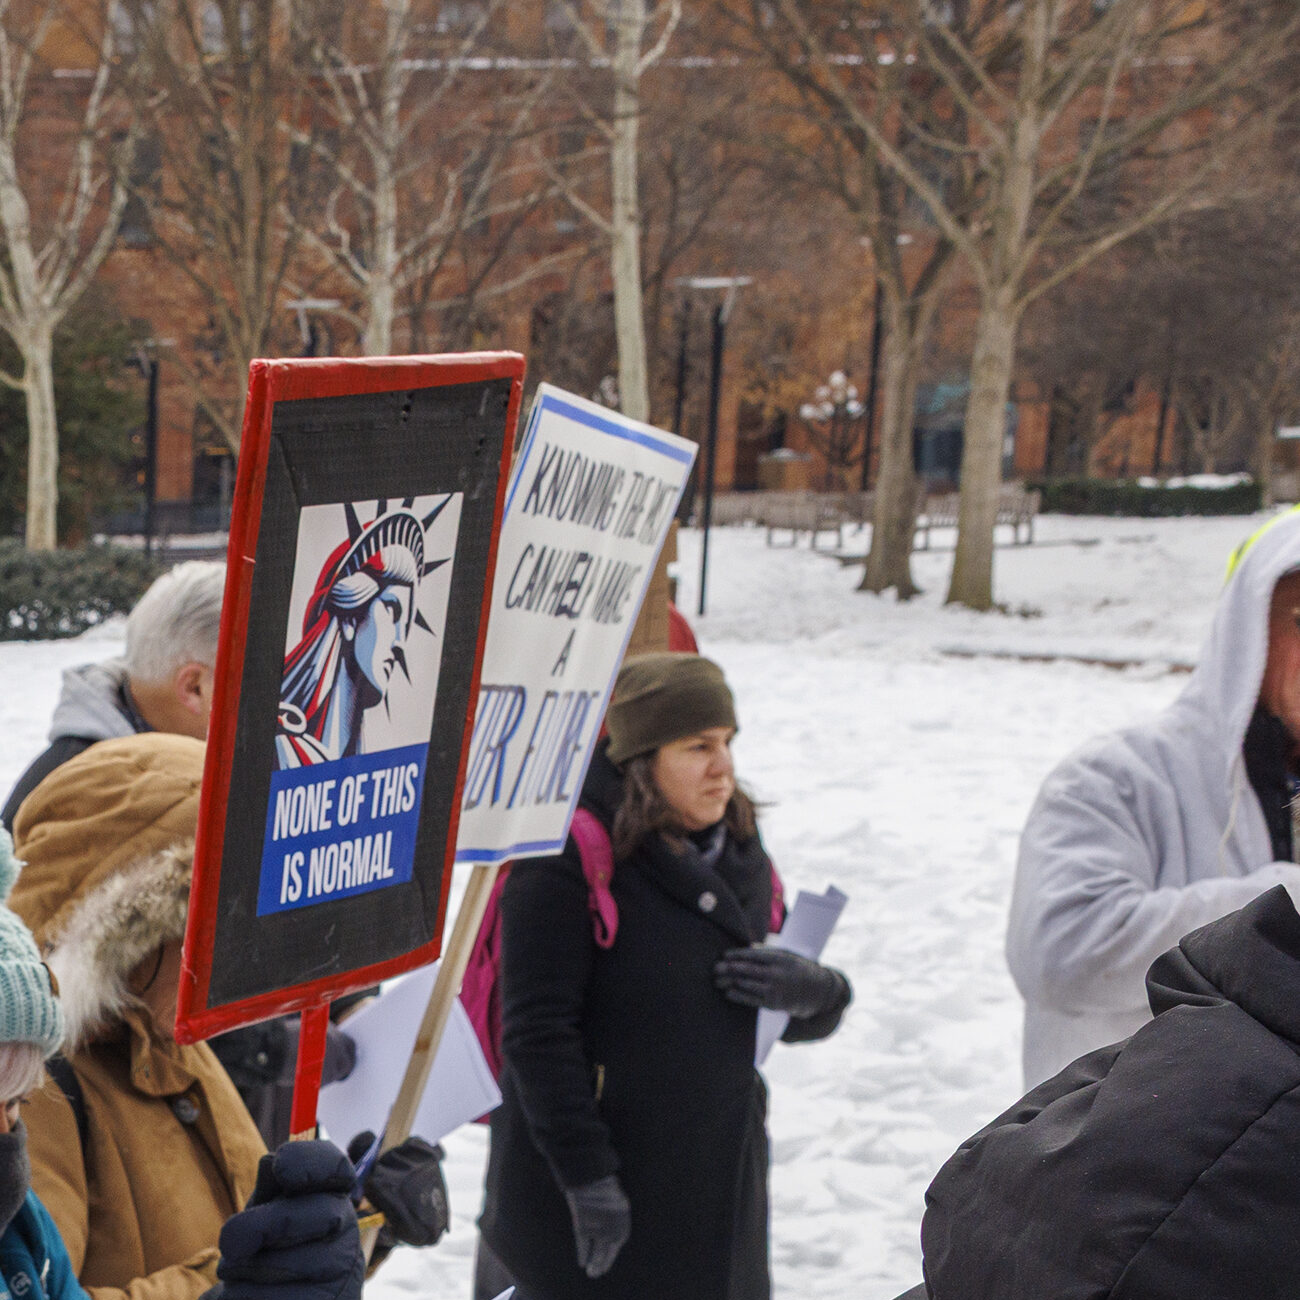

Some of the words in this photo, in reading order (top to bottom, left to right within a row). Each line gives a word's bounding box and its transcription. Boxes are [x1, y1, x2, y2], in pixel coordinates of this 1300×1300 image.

[523, 442, 625, 531] KNOWING
[551, 628, 576, 677] A
[272, 780, 336, 841] NONE
[337, 772, 369, 826] OF
[370, 762, 419, 819] THIS
[280, 851, 304, 904] IS
[307, 830, 394, 898] NORMAL
